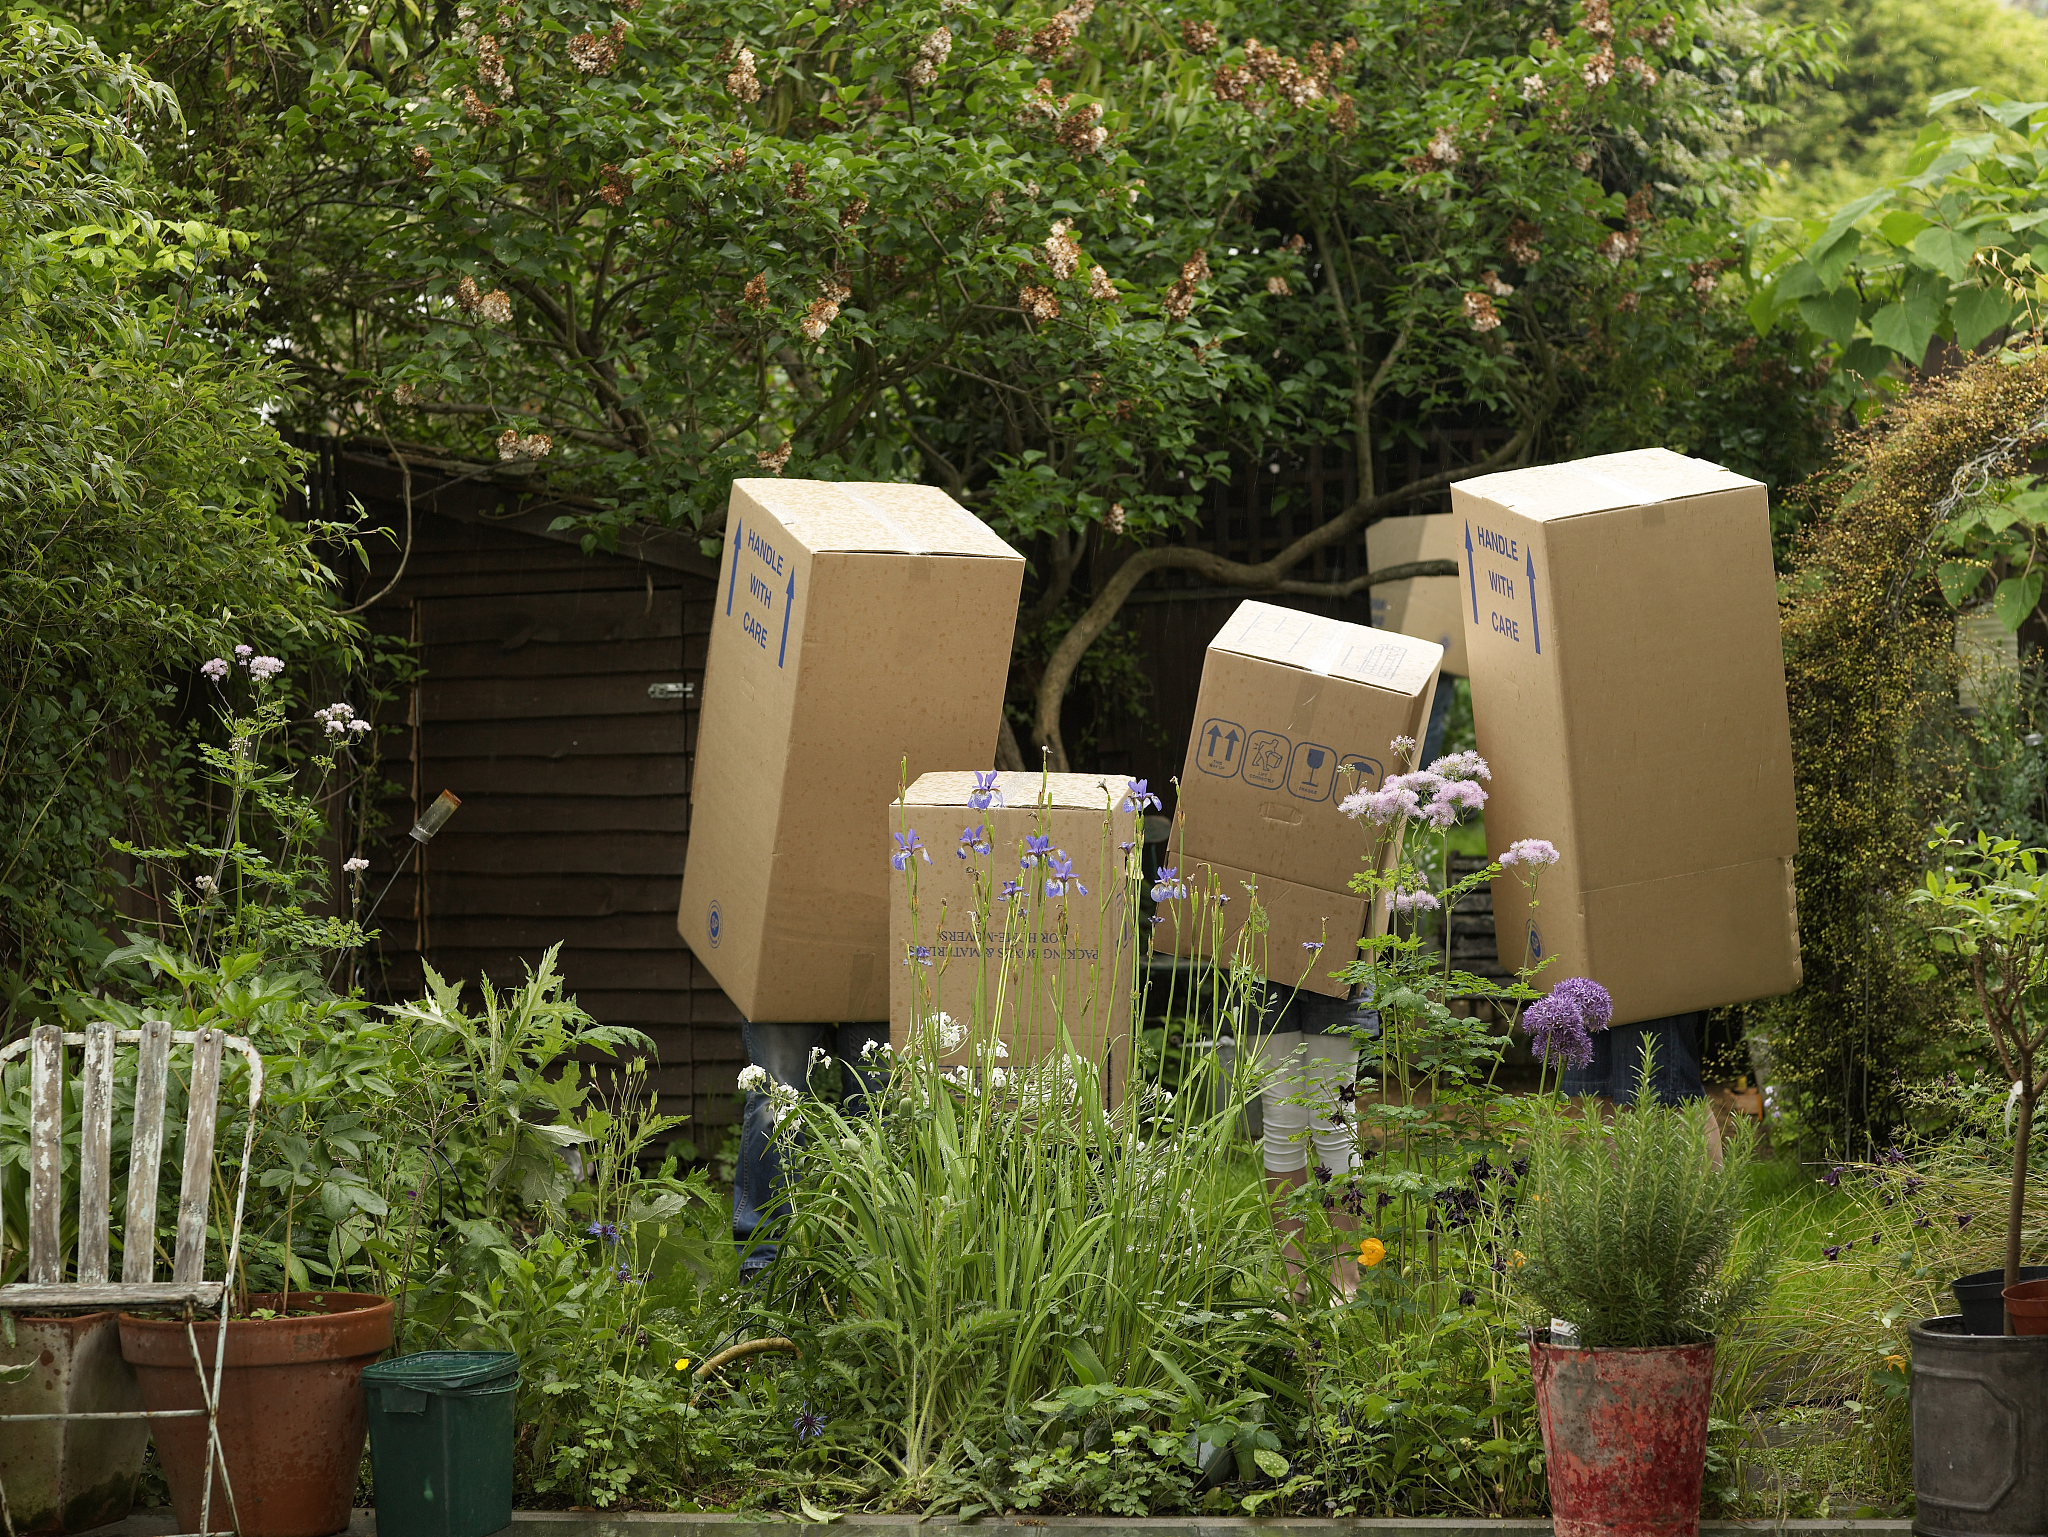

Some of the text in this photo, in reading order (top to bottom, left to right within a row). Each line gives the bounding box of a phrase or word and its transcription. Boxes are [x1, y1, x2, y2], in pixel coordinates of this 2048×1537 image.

[747, 529, 784, 577] HANDLE
[1477, 525, 1518, 561] HANDLE
[750, 573, 772, 609] WITH
[1488, 570, 1514, 600] WITH
[743, 611, 768, 650] CARE
[1491, 611, 1520, 642] CARE
[1299, 786, 1318, 794] FRAGILE
[908, 946, 981, 957] MATRIAS
[1043, 949, 1099, 960] PACKNG
